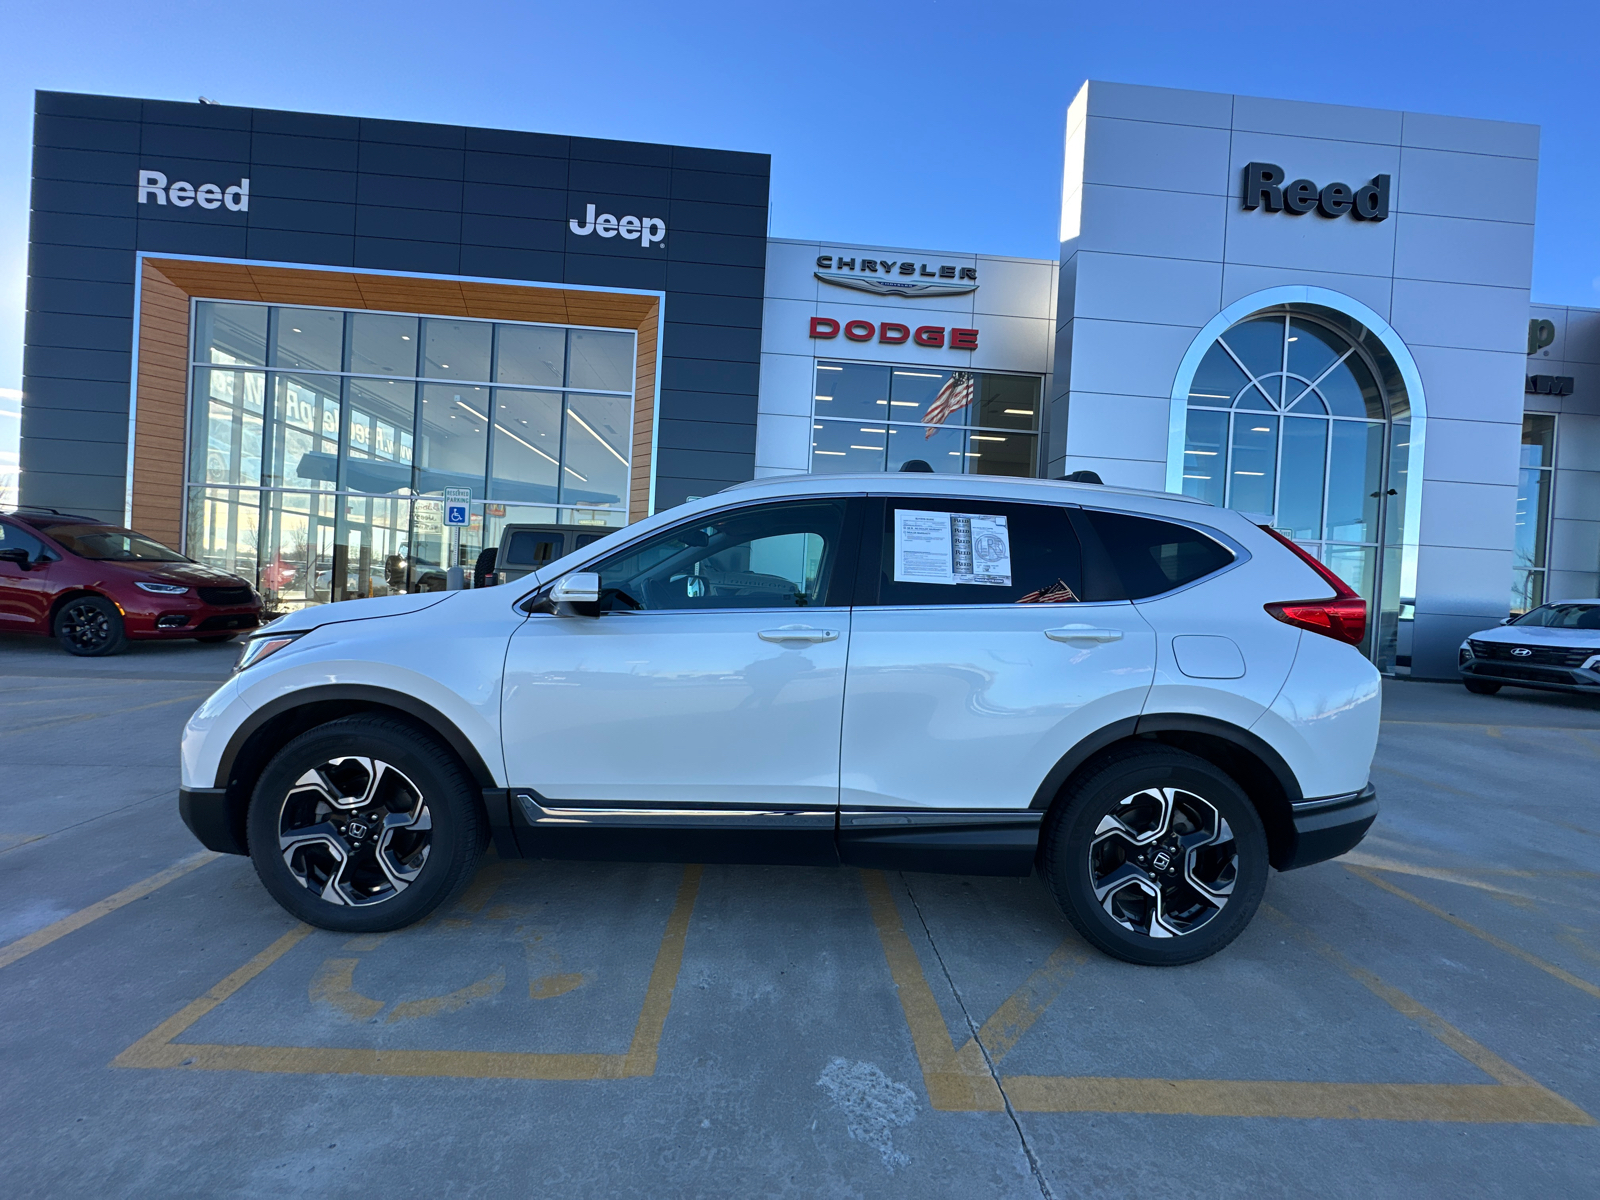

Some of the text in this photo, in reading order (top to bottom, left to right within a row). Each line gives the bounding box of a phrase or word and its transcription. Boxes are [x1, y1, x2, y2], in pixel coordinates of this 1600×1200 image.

[138, 169, 250, 212] Reed
[1243, 161, 1391, 222] Reed
[569, 203, 666, 248] Jeep
[816, 255, 978, 280] CHRYSLER
[809, 316, 979, 350] DODGE
